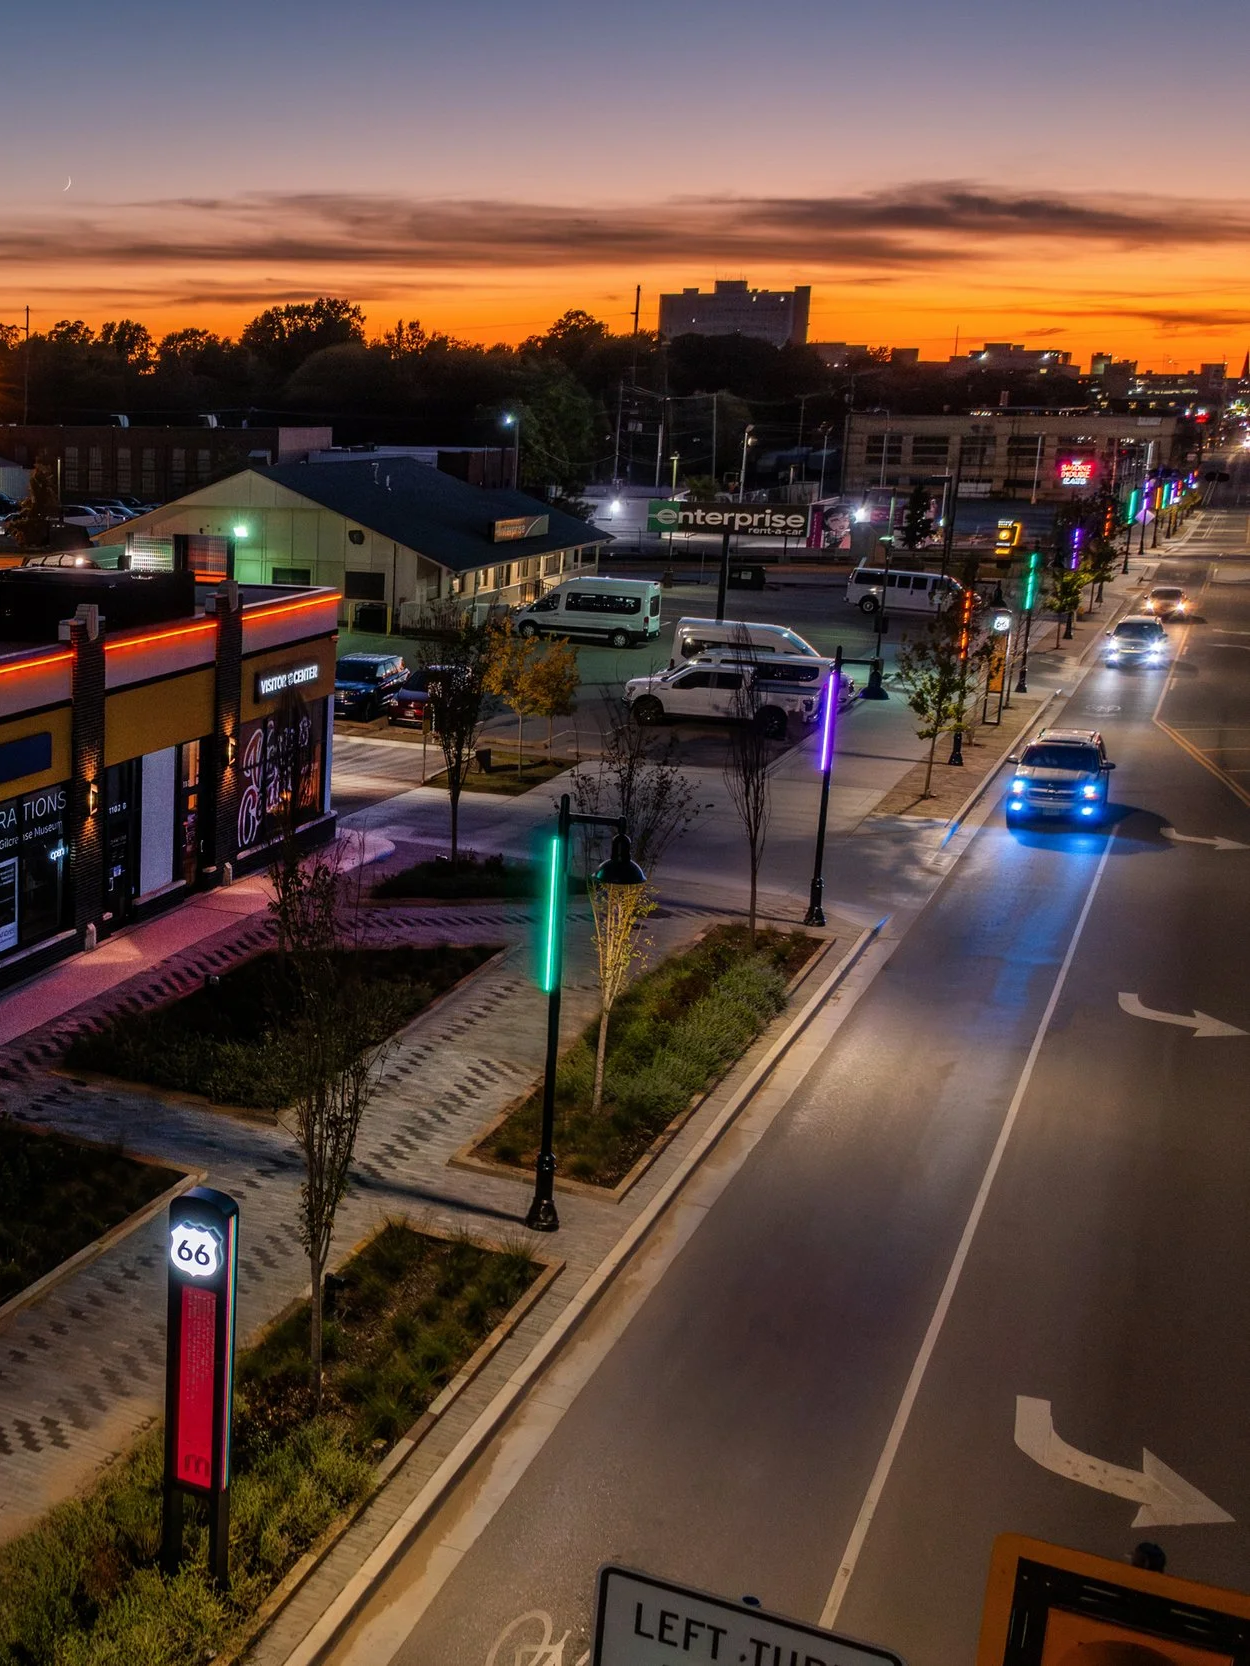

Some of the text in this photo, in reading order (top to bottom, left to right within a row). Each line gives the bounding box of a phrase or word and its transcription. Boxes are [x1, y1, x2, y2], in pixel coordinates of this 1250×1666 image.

[656, 509, 805, 531] enterprise
[748, 527, 803, 536] rent-a-car
[261, 674, 287, 694] VISITOR
[293, 665, 318, 684] CENTER
[34, 820, 63, 838] Museum
[50, 847, 65, 861] open
[177, 1239, 211, 1267] 66
[634, 1602, 727, 1660] LEFT
